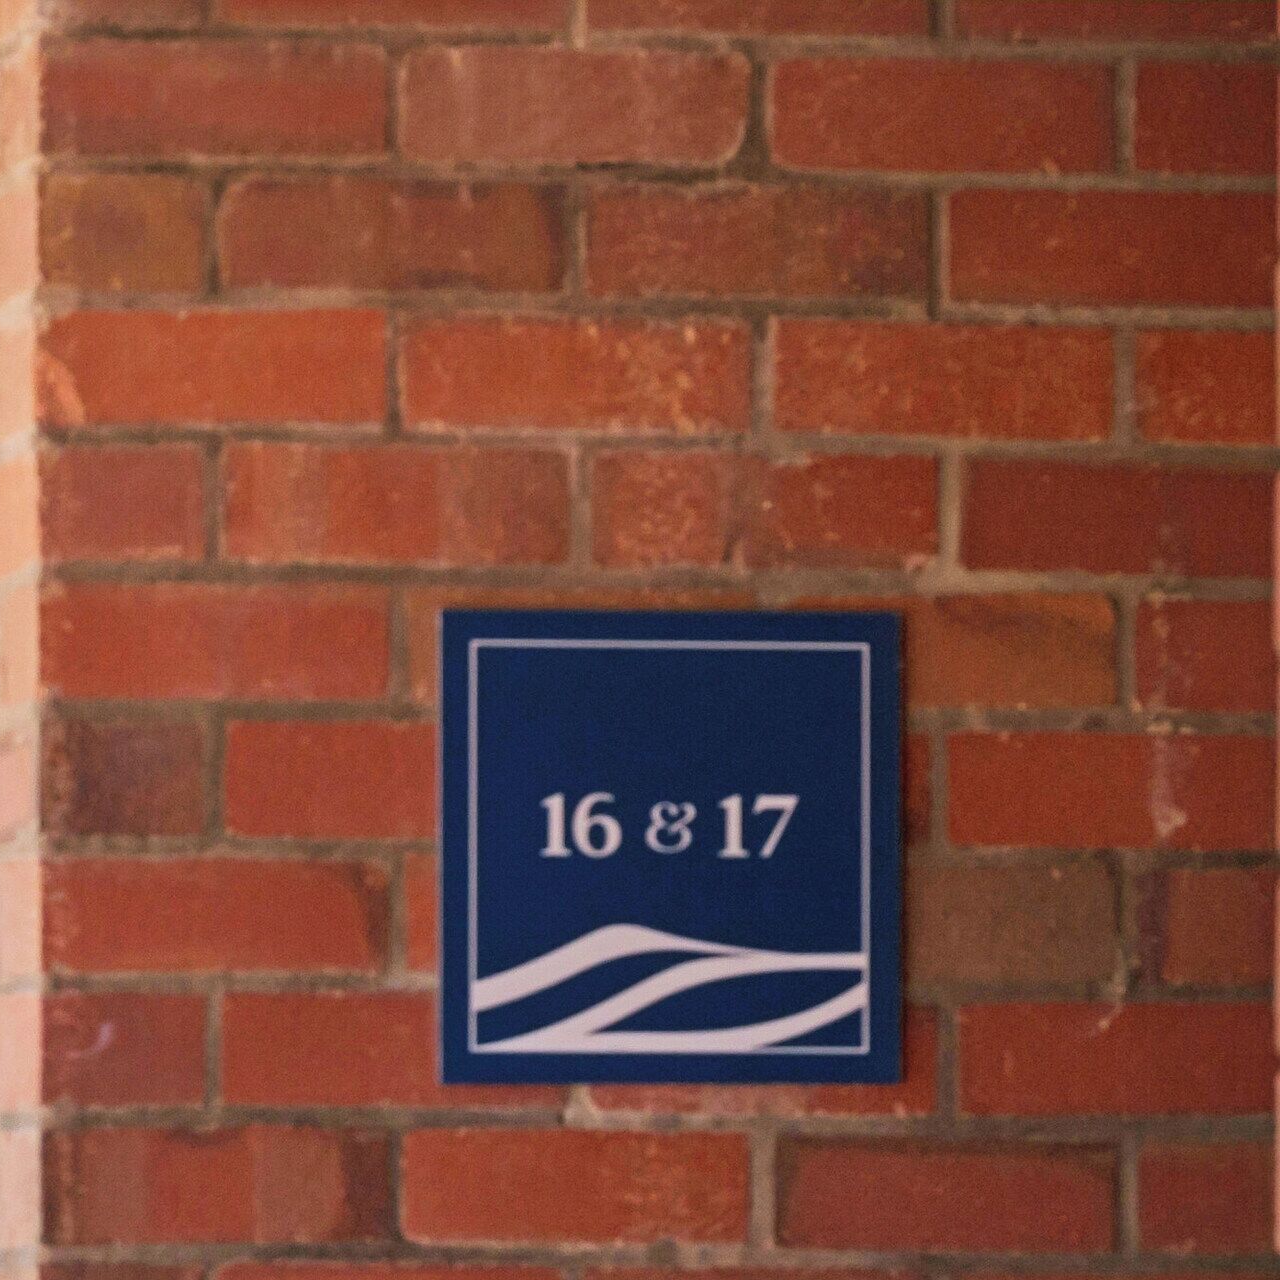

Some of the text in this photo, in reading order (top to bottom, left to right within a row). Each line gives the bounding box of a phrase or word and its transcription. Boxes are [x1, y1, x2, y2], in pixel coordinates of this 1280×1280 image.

[541, 791, 801, 860] 16 & 17
